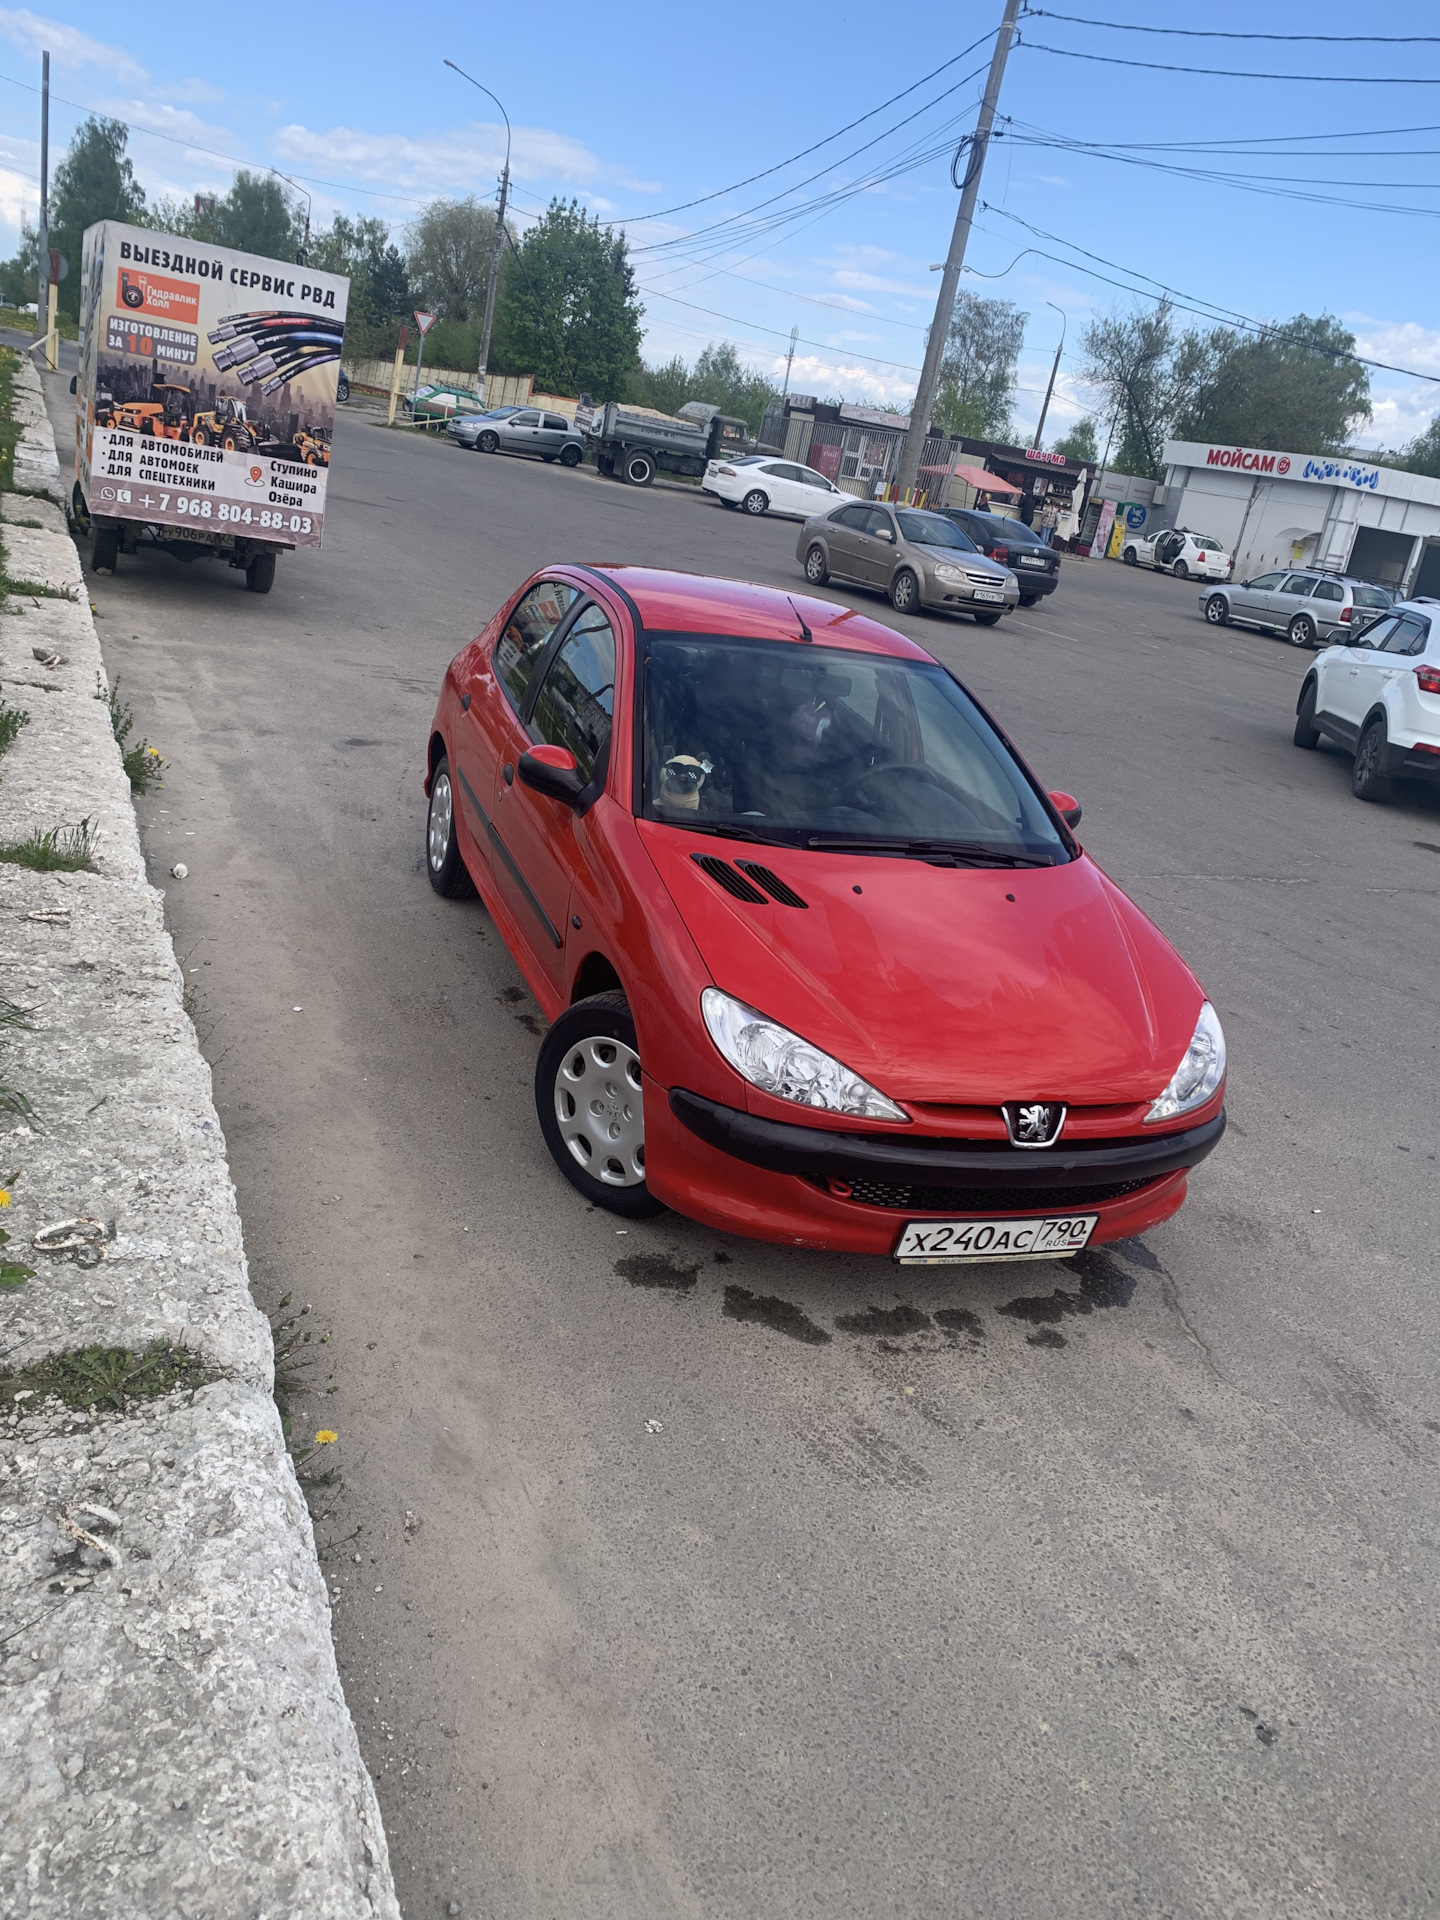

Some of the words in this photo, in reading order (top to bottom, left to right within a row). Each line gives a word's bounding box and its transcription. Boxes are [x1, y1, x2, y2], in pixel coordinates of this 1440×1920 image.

[120, 241, 223, 281] ВЫЕЗДНОЙ
[230, 268, 295, 298] СЕРВИС
[300, 284, 335, 309] РВД
[146, 285, 197, 306] Гидравлик
[146, 295, 170, 309] Холл
[109, 317, 197, 347] ИЗГОТОВЛЕНИЕ
[108, 334, 123, 348] ЗА
[128, 334, 153, 355] 10
[157, 344, 196, 363] МИНУТ
[109, 434, 134, 447] ДЛЯ
[141, 439, 224, 463] АВТОМОБИЛЕЙ
[1025, 449, 1066, 466] ШАУРМА
[1206, 448, 1276, 473] МОЙСАМ
[108, 449, 133, 463] ДЛЯ
[140, 455, 199, 474] АВТОМОЕК
[270, 460, 318, 479] Ступино
[107, 464, 132, 477] ДЛЯ
[139, 469, 216, 491] СПЕЦТЕХНИКИ
[270, 476, 317, 494] Кашира
[268, 491, 303, 507] Озёра
[177, 496, 212, 518] 968
[217, 503, 312, 534] 804-88-03
[908, 1225, 1034, 1252] Х240АС
[1041, 1219, 1087, 1242] 790
[1046, 1238, 1068, 1248] RUS
